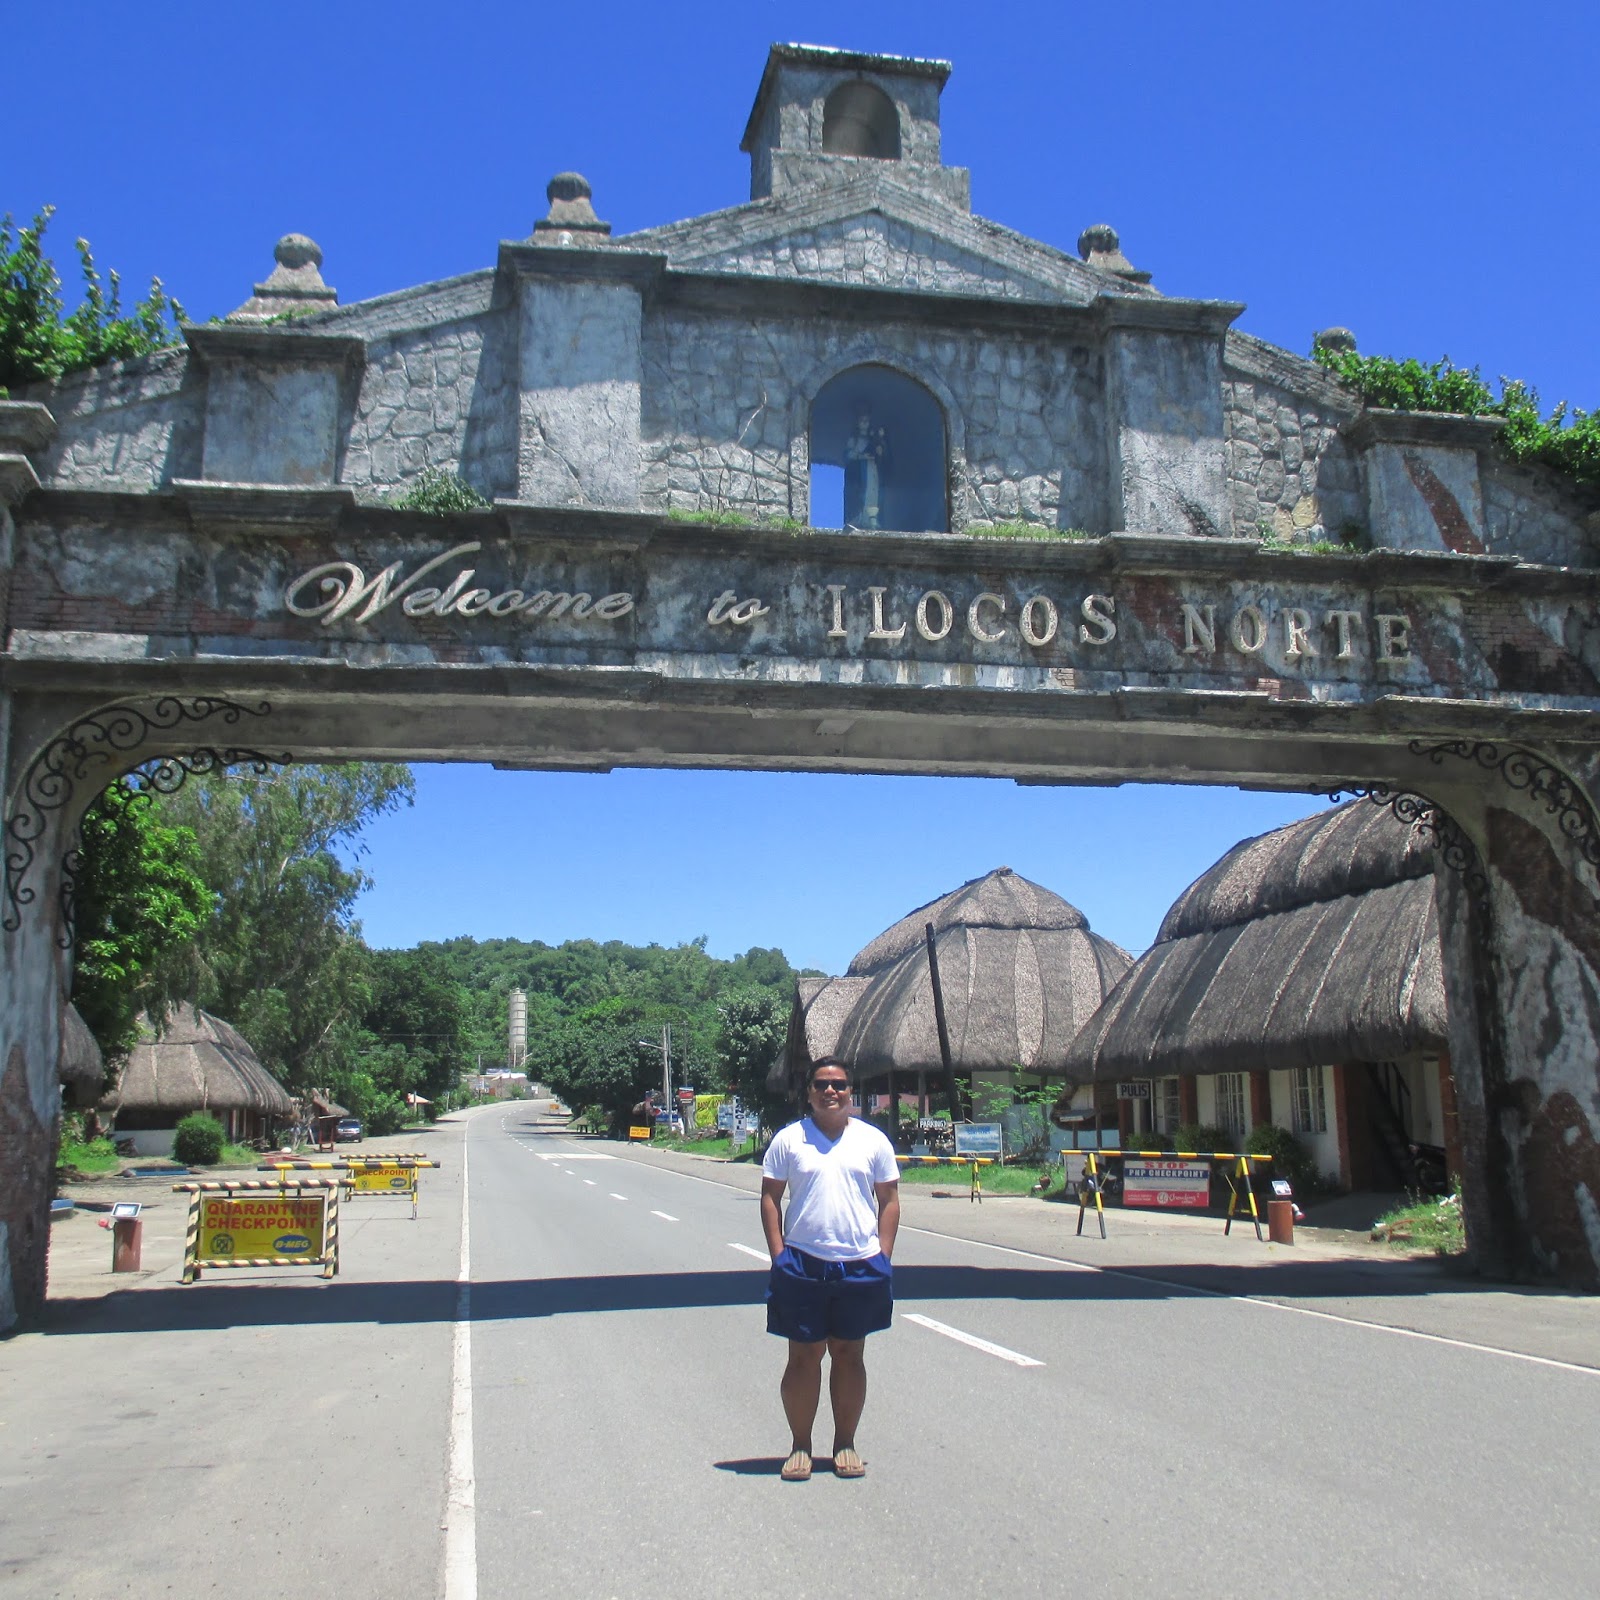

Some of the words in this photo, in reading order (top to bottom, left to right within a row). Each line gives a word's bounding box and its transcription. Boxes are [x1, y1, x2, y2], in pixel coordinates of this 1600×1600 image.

[285, 541, 634, 626] Welcome
[707, 588, 772, 625] to
[825, 583, 1118, 647] ILOCOS
[1181, 603, 1413, 664] NORTE
[1120, 1084, 1147, 1097] PULIS
[1144, 1161, 1189, 1169] STOP
[1148, 1169, 1204, 1178] CHECKPOINT
[207, 1202, 318, 1215] QUARANTINE
[206, 1217, 318, 1229] CHECKPOINT
